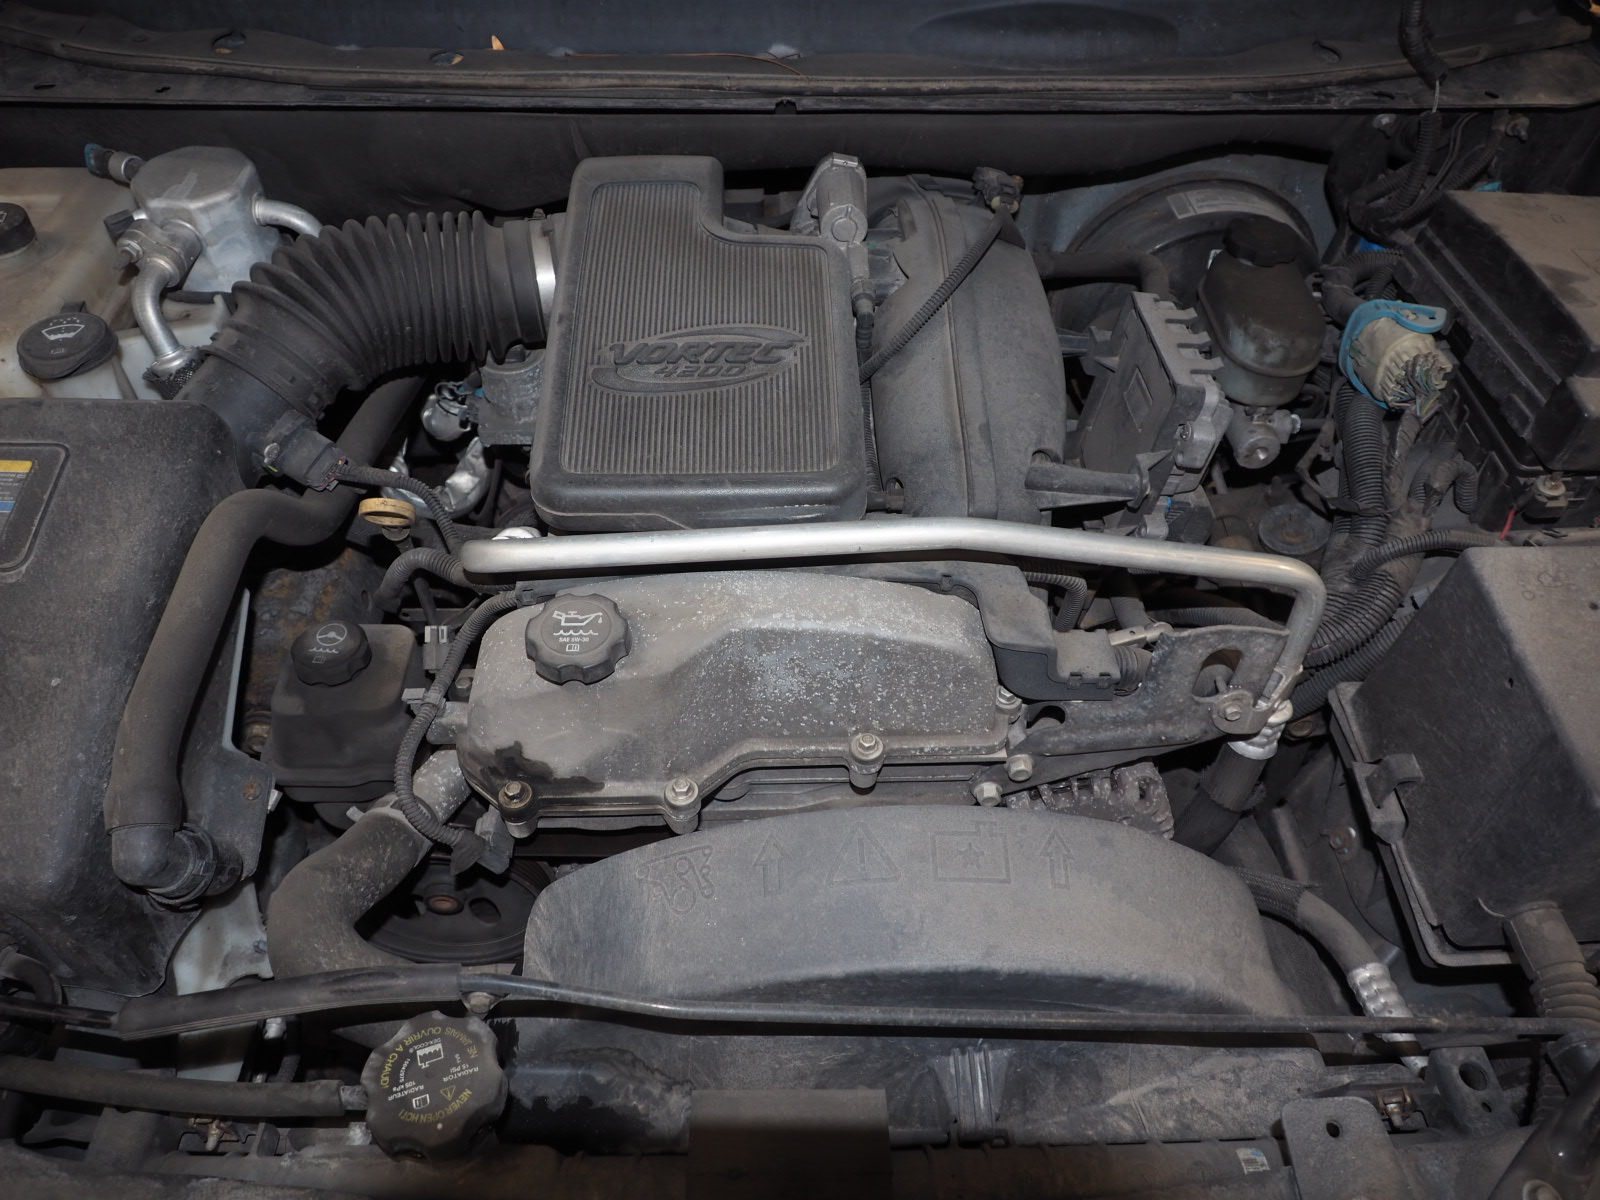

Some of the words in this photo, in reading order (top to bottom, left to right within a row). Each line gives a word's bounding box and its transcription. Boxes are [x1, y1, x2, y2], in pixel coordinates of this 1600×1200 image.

[609, 341, 797, 366] VORTEC
[654, 365, 747, 378] 4200
[403, 1026, 442, 1046] OUVRIR
[445, 1027, 472, 1046] JAMAIS
[395, 1044, 404, 1052] A
[467, 1045, 479, 1059] NE
[380, 1052, 399, 1089] CHAUD!
[442, 1066, 479, 1082] RADIATOR
[450, 1064, 461, 1073] PSI
[387, 1085, 425, 1101] RADIATEUR
[392, 1084, 404, 1092] kPa
[445, 1088, 473, 1115] NEVER
[398, 1108, 419, 1122] HOT!
[420, 1110, 446, 1123] OPEN
